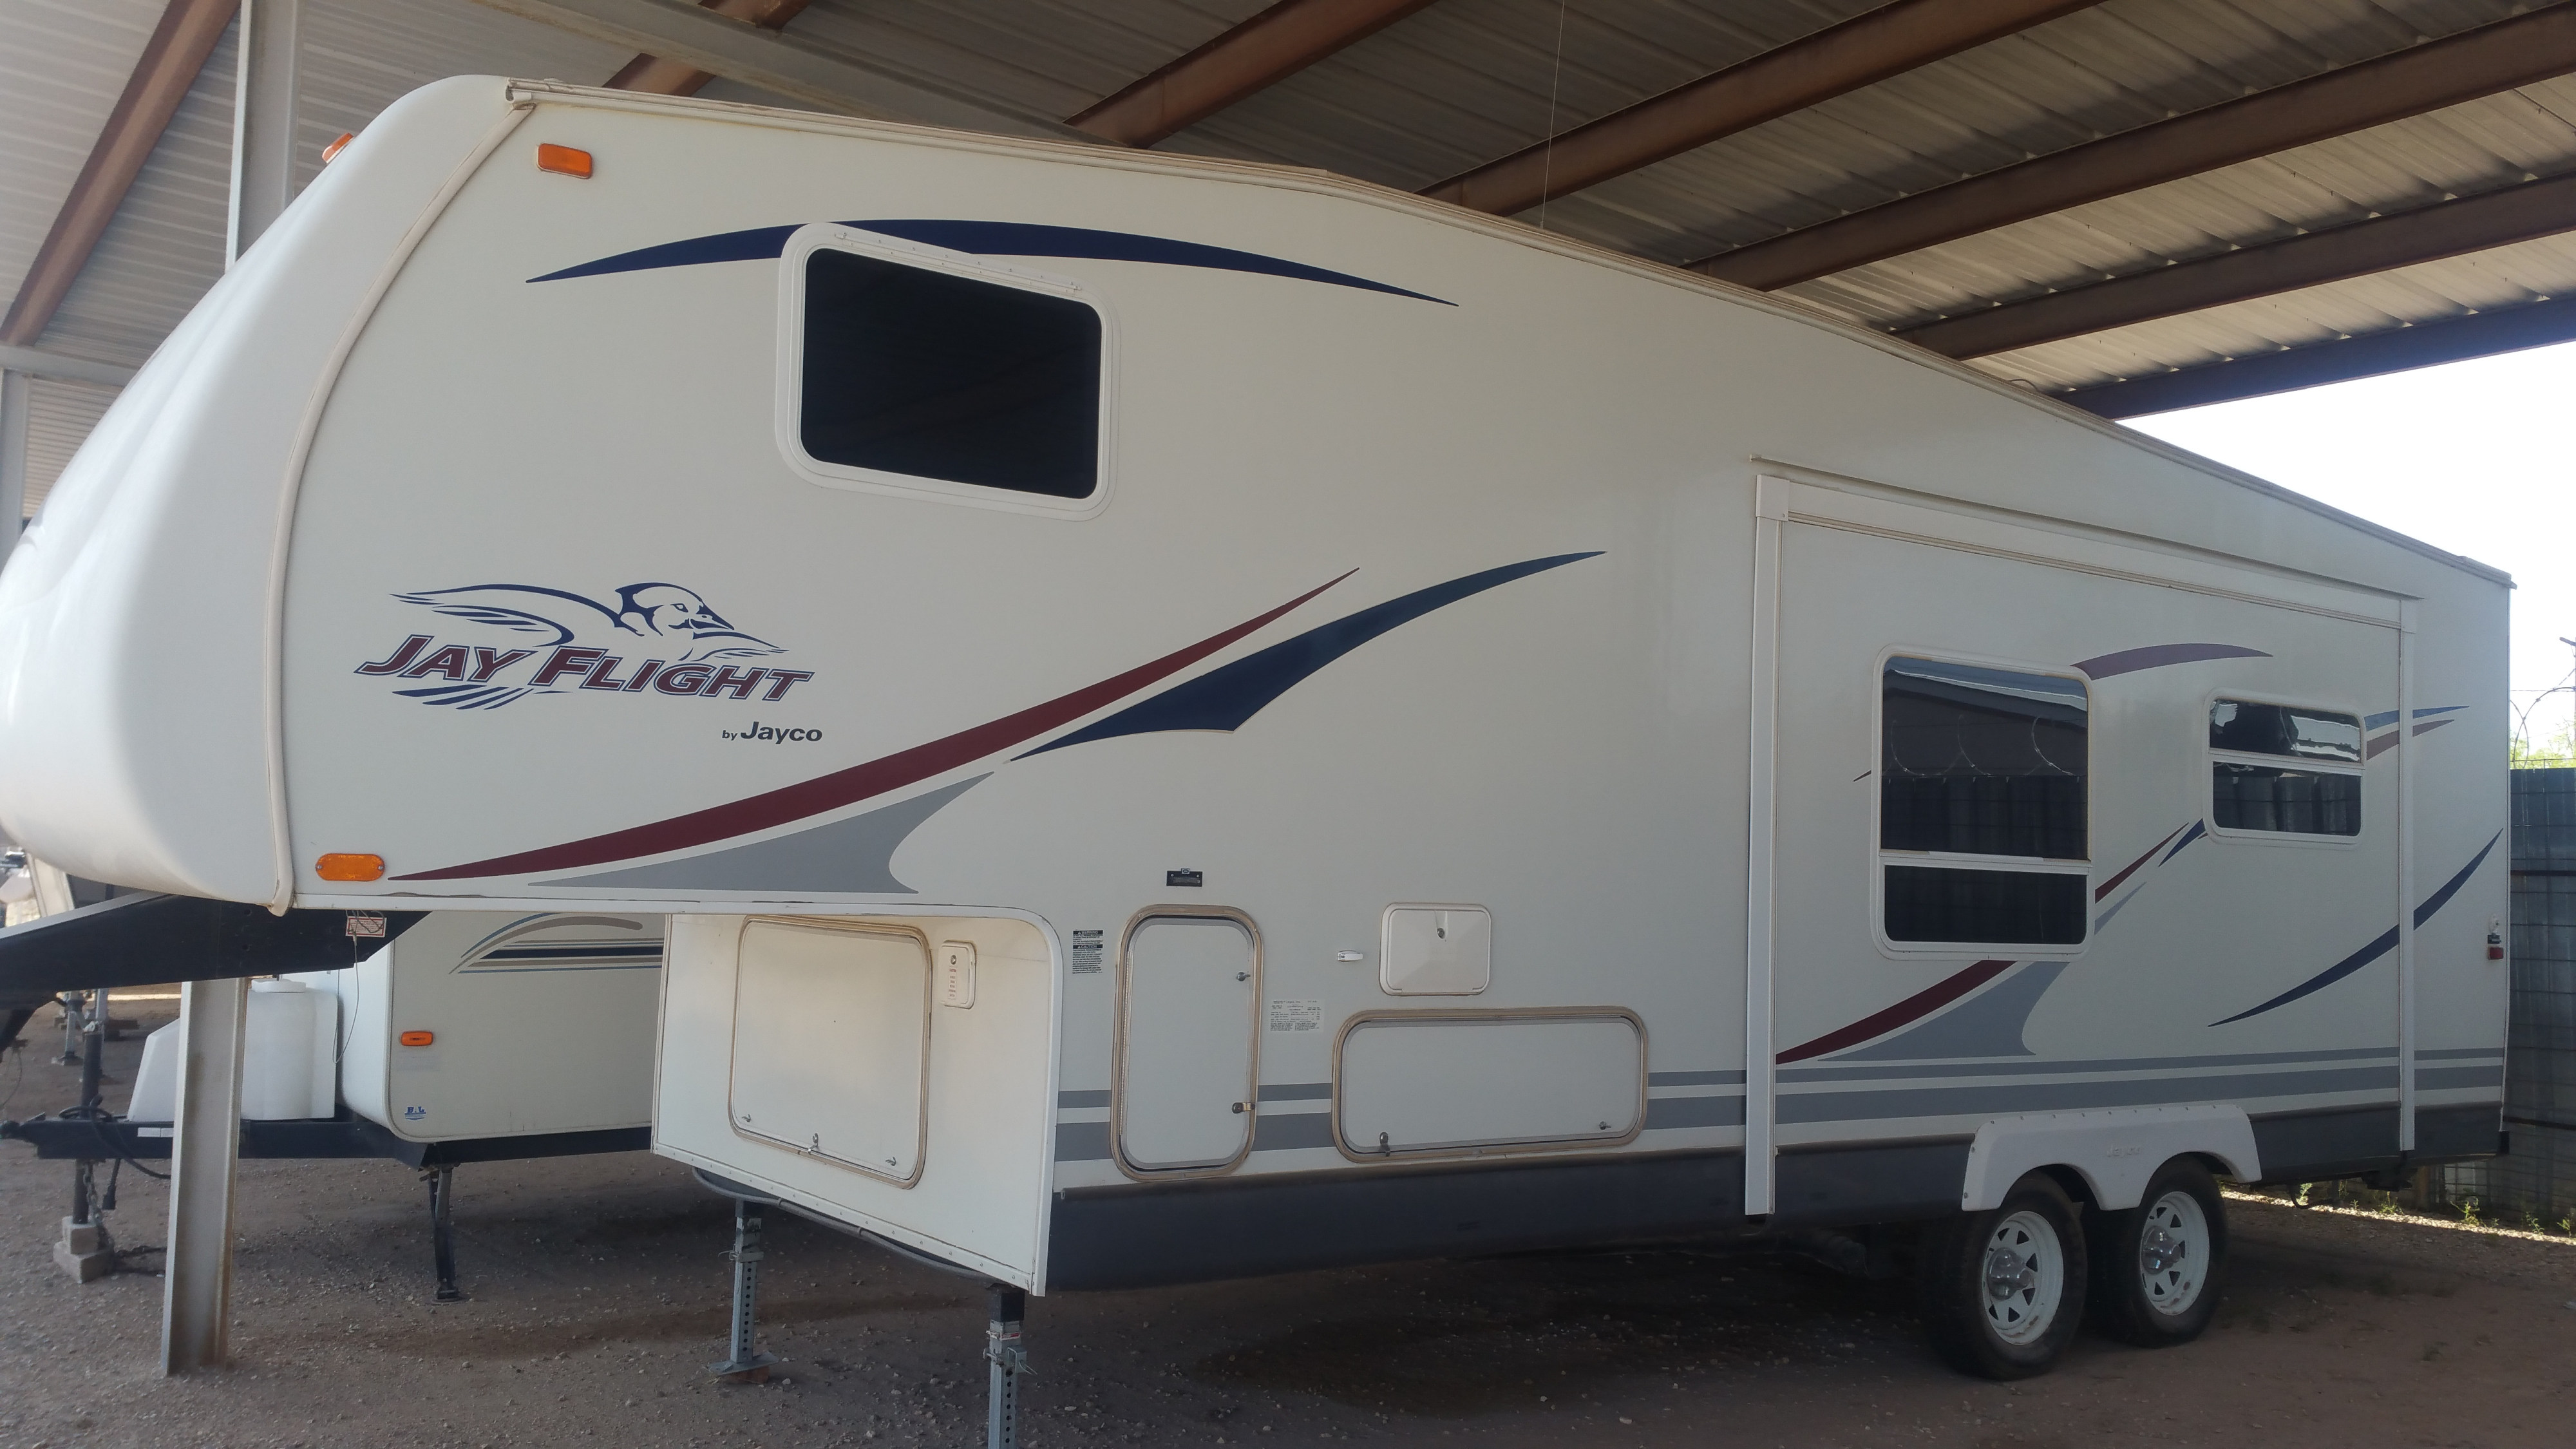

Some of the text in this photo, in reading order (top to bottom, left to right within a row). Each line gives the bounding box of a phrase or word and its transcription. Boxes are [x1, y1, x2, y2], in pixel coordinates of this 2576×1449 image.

[354, 634, 815, 701] JAY FLIGHT
[722, 721, 822, 744] by Jayco
